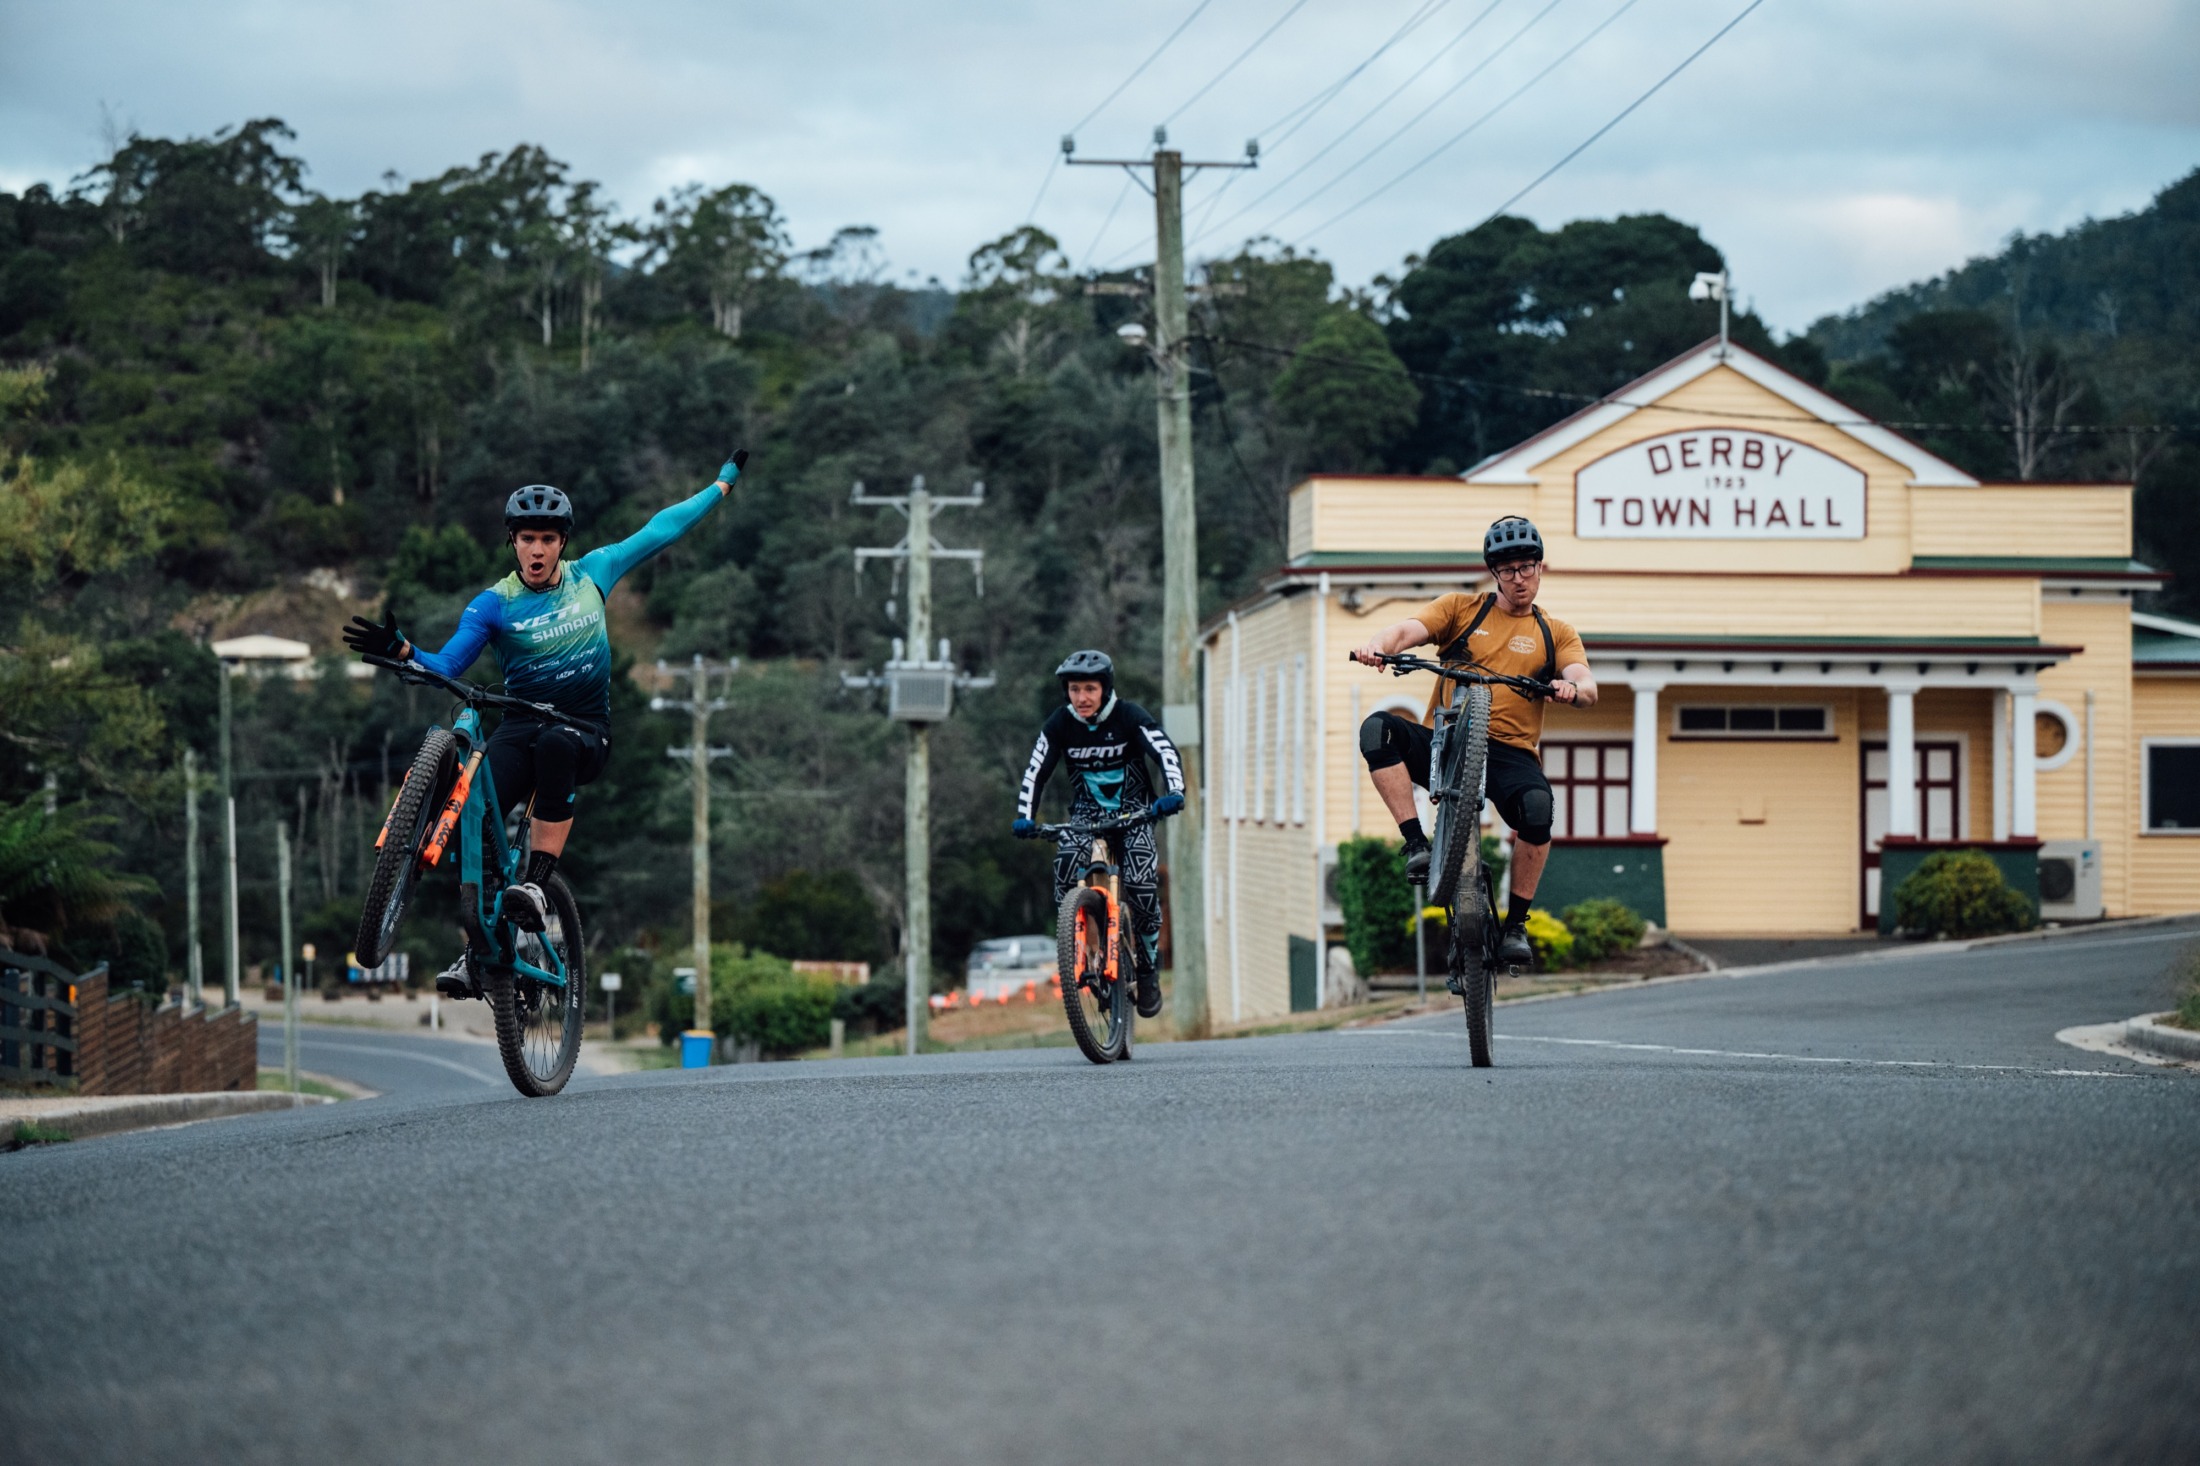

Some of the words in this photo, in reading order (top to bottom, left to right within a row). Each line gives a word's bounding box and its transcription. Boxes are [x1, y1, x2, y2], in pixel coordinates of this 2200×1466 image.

[1647, 437, 1793, 476] DERBY
[1593, 498, 1711, 527] TOWN
[1734, 498, 1842, 527] HALL
[512, 602, 580, 631] YETI
[532, 611, 599, 643] SHIMANO
[1067, 741, 1128, 759] GIANT
[1017, 731, 1049, 820] GIANT
[572, 994, 579, 1009] DT
